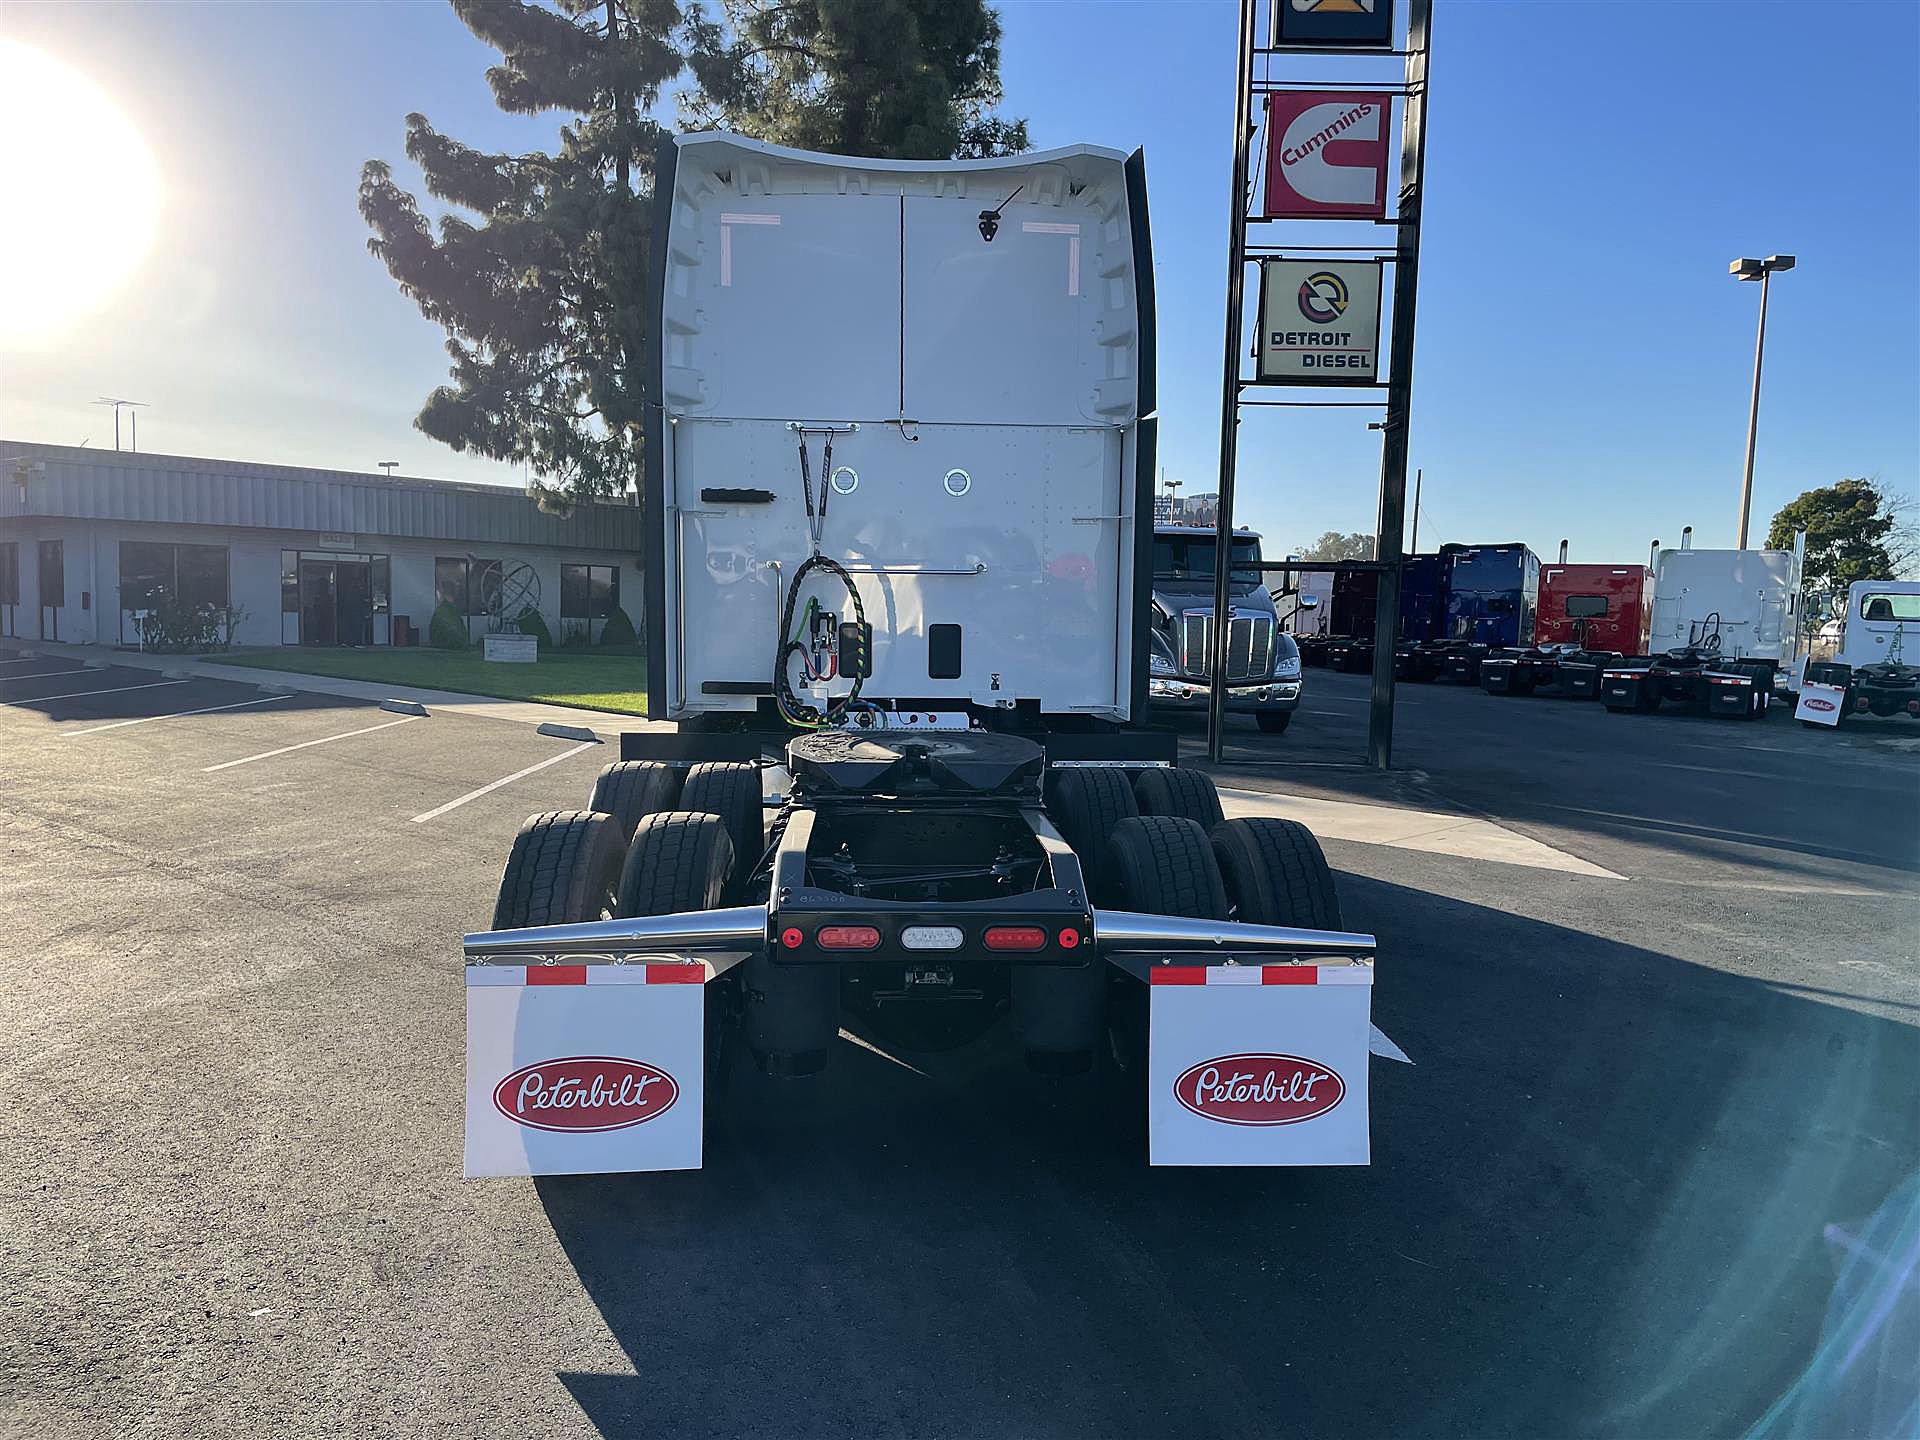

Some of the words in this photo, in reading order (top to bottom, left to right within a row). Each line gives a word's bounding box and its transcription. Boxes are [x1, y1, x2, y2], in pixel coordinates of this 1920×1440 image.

[1281, 103, 1372, 166] Cummins
[1271, 332, 1351, 346] DETROIT
[1302, 354, 1371, 368] DIESEL
[516, 1072, 662, 1114] Peterbilt
[1195, 1067, 1329, 1106] Peterbilt
